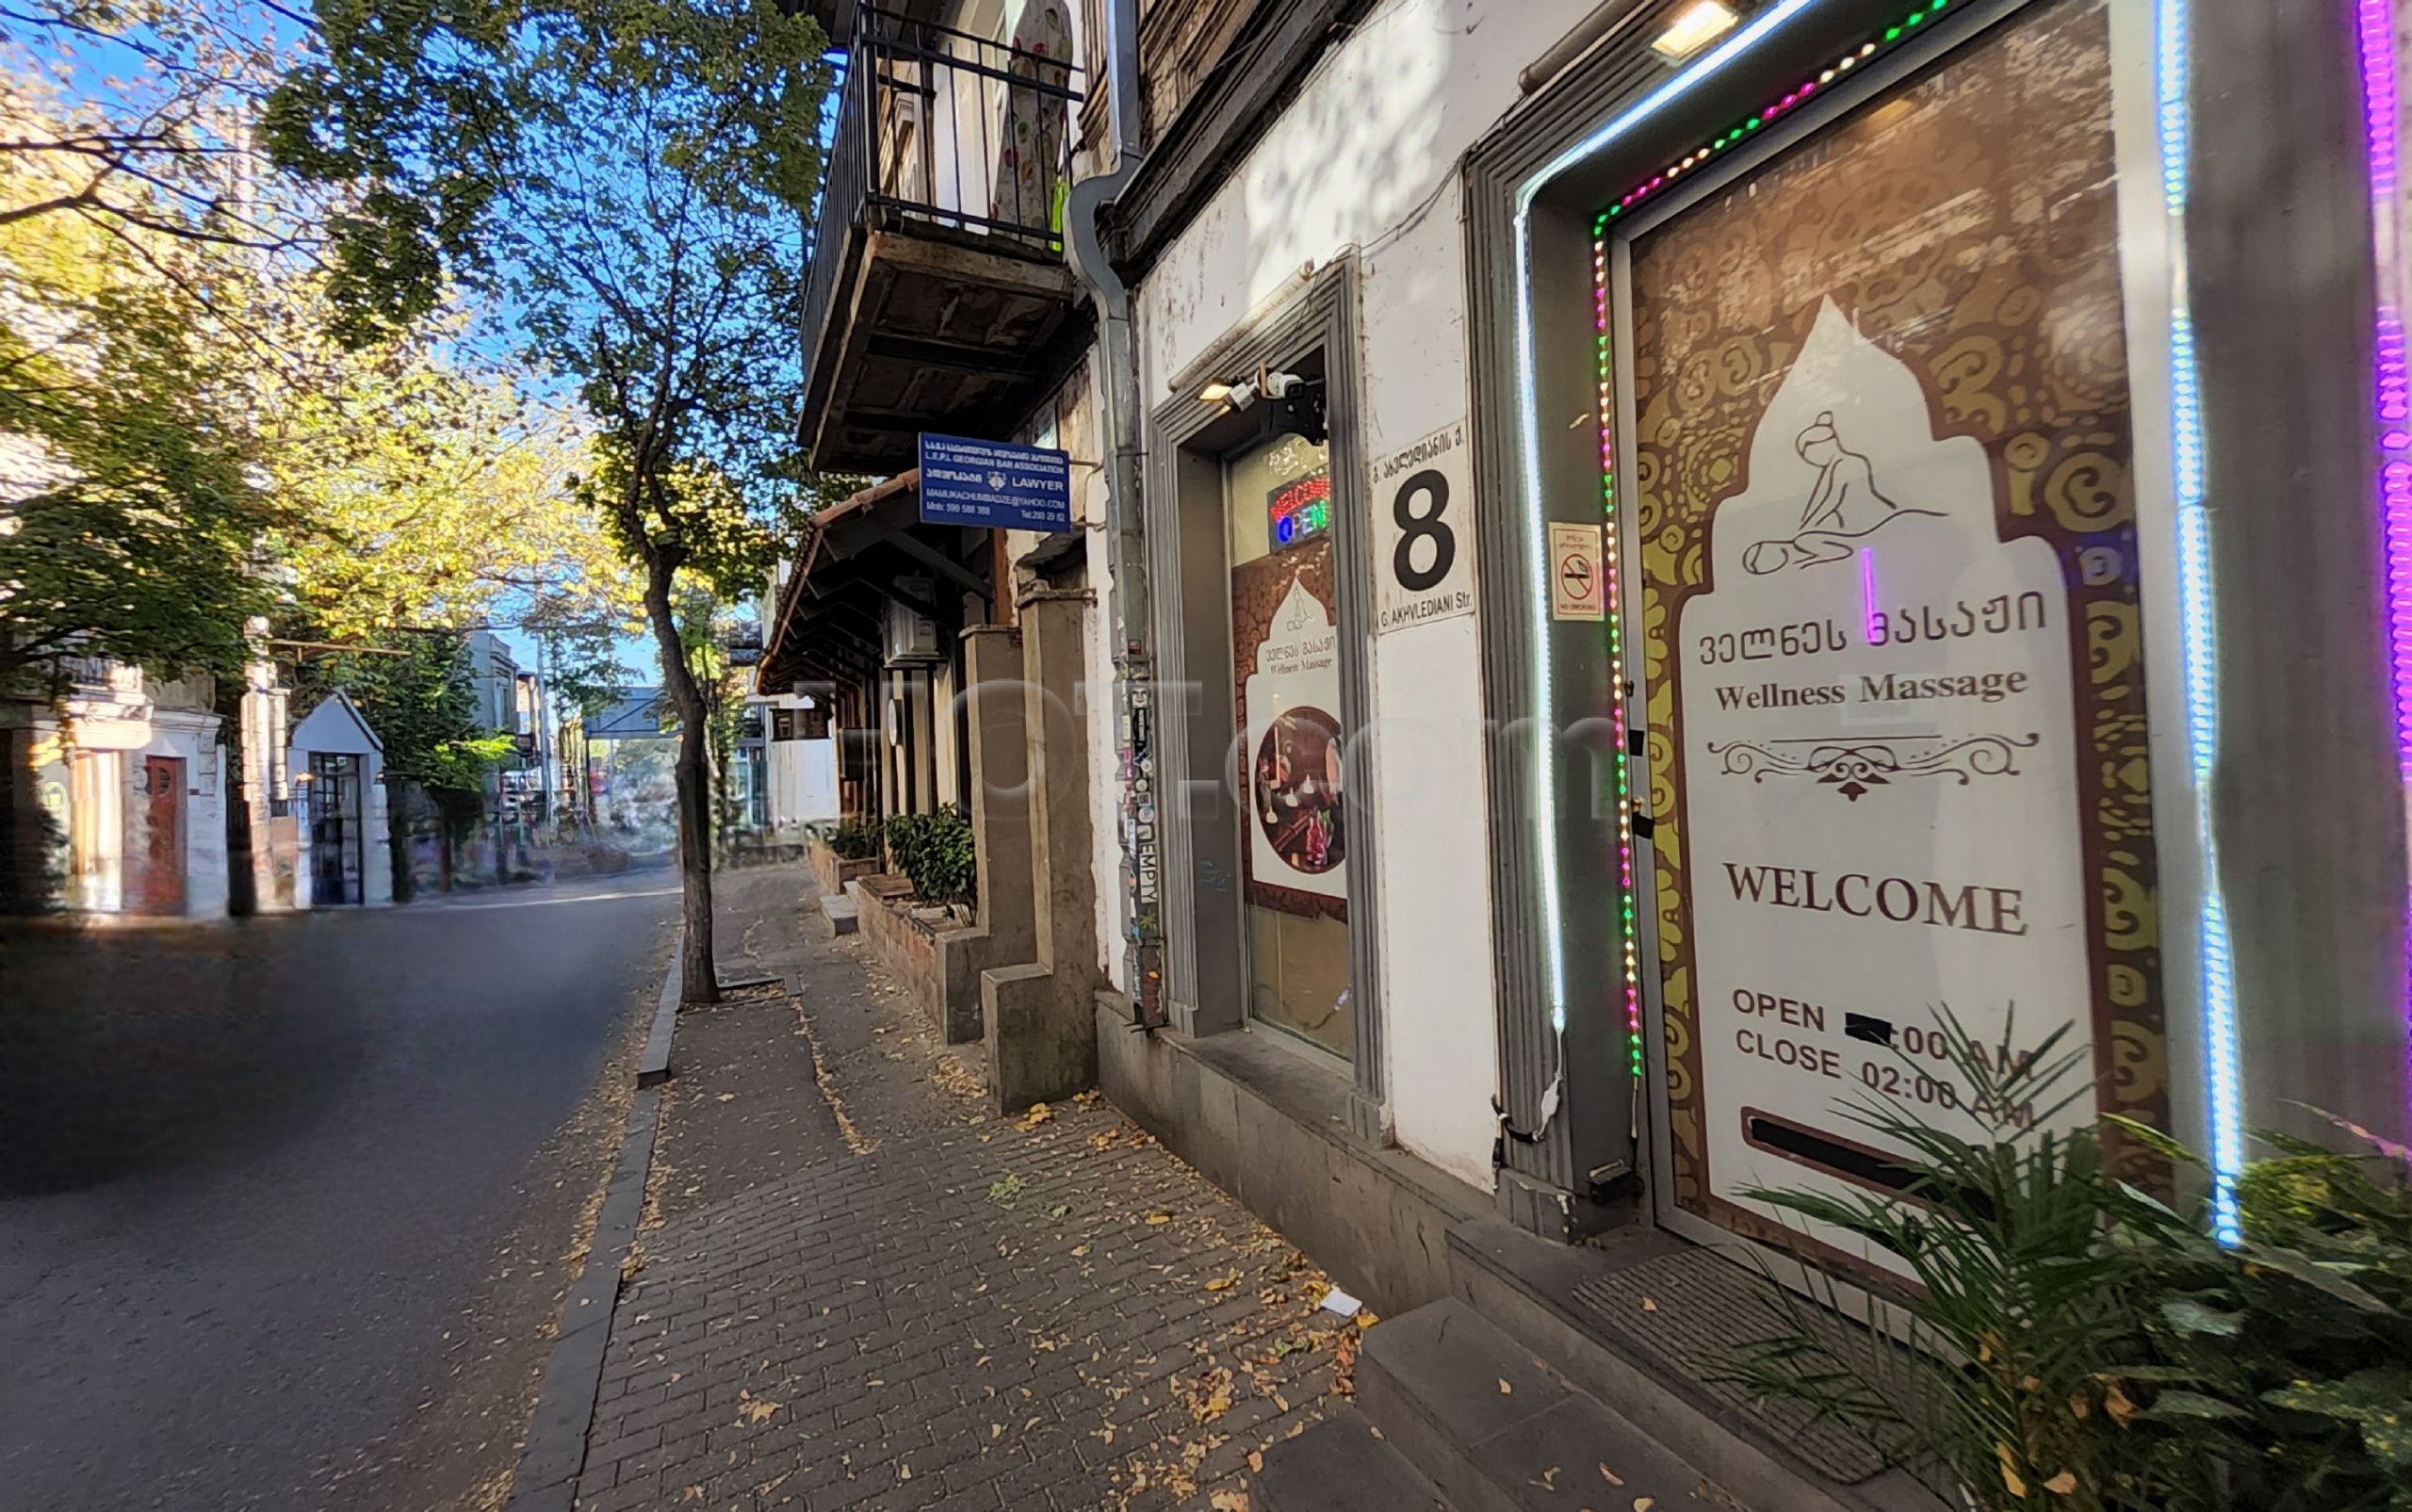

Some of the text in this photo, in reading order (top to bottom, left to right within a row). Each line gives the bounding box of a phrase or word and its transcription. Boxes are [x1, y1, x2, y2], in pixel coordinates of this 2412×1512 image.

[953, 455, 995, 467] GEORGIAN
[996, 460, 1013, 469] BAR
[1014, 462, 1065, 475] ASSOCIATION
[1012, 477, 1064, 491] LAWYER
[1278, 500, 1327, 544] OPEN
[1393, 469, 1456, 592] 8
[1380, 591, 1473, 627] G. AKHVLEDIANI Str.
[1699, 591, 2046, 665] ველნეს მასაჟი
[1270, 658, 1332, 675] Wellness Massage
[1715, 671, 2029, 711] Wellness Massage
[1140, 843, 1158, 902] EMPTY
[1721, 862, 2029, 936] WELCOME
[1733, 988, 1825, 1032] OPEN
[1736, 1030, 1841, 1080] CLOSE
[1862, 1062, 1957, 1111] 02:00
